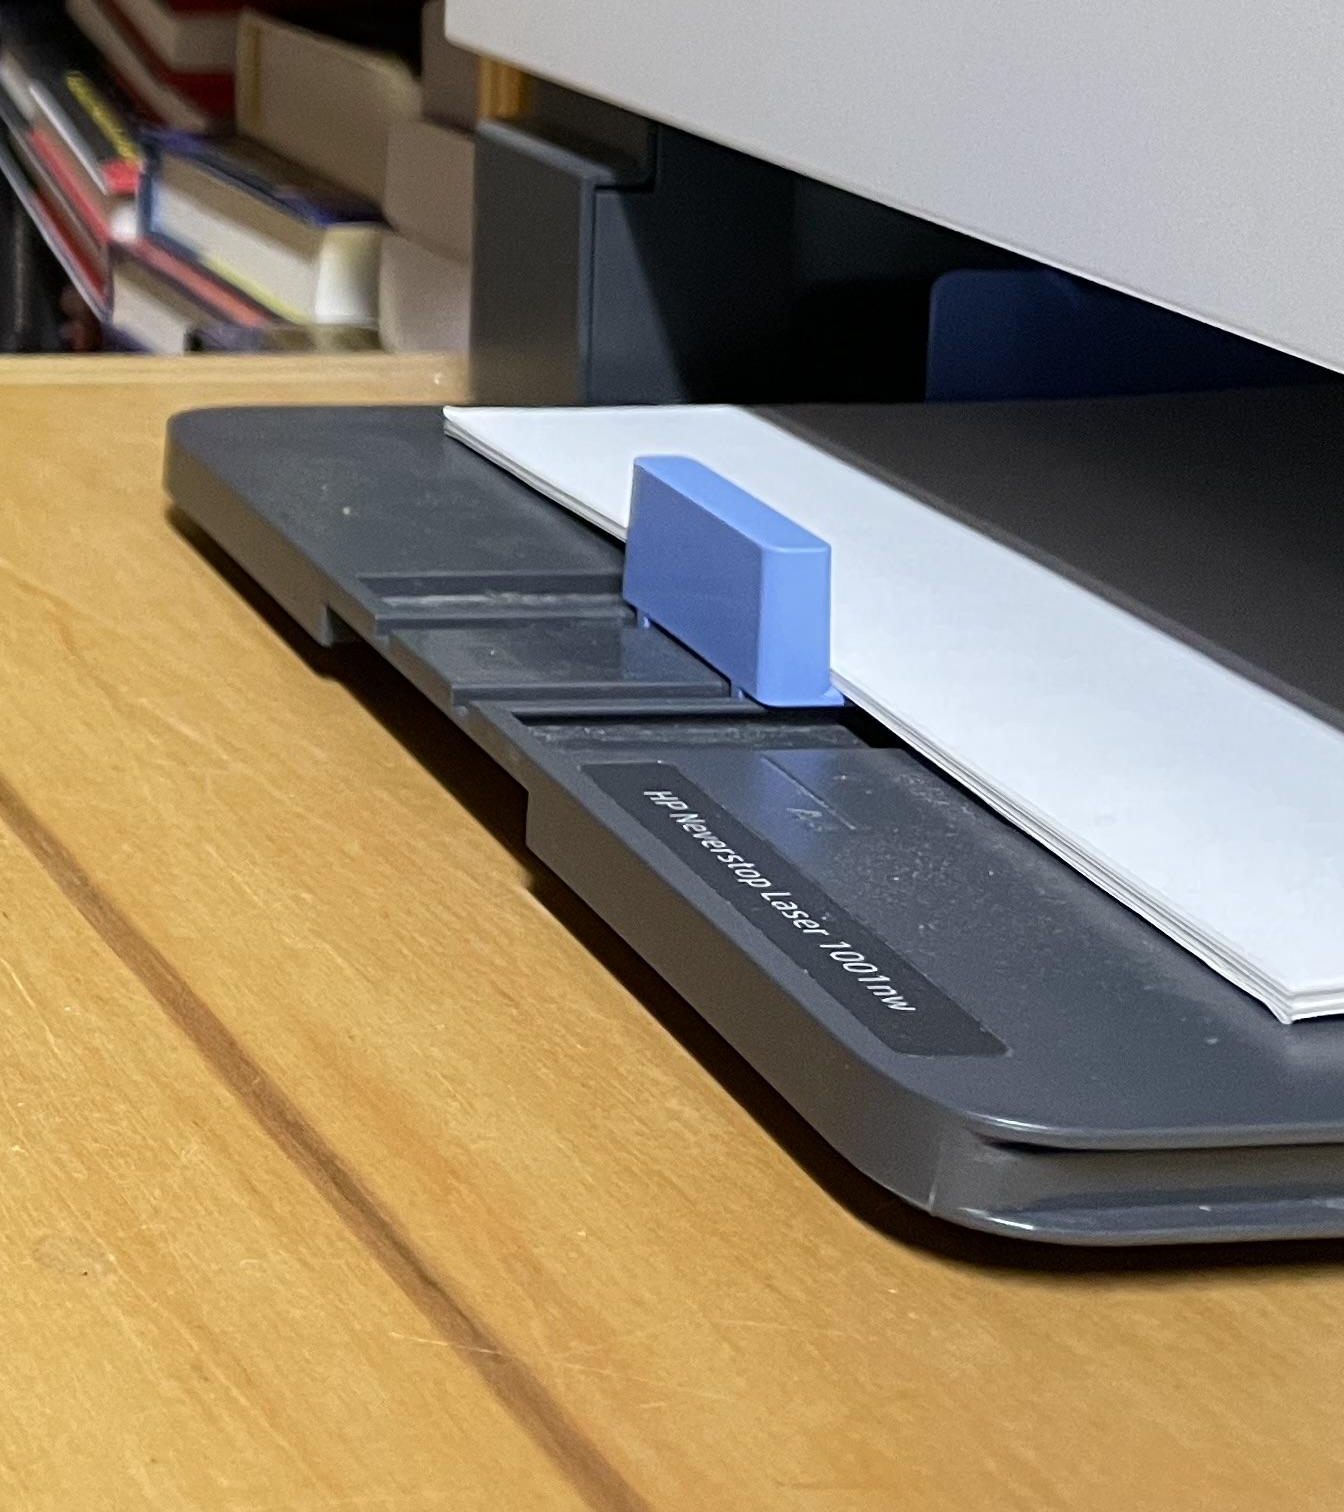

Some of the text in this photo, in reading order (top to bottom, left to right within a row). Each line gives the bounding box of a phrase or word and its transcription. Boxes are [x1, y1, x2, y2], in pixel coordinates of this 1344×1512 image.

[643, 789, 918, 1013] HP Neverstop Laser 1001nw
